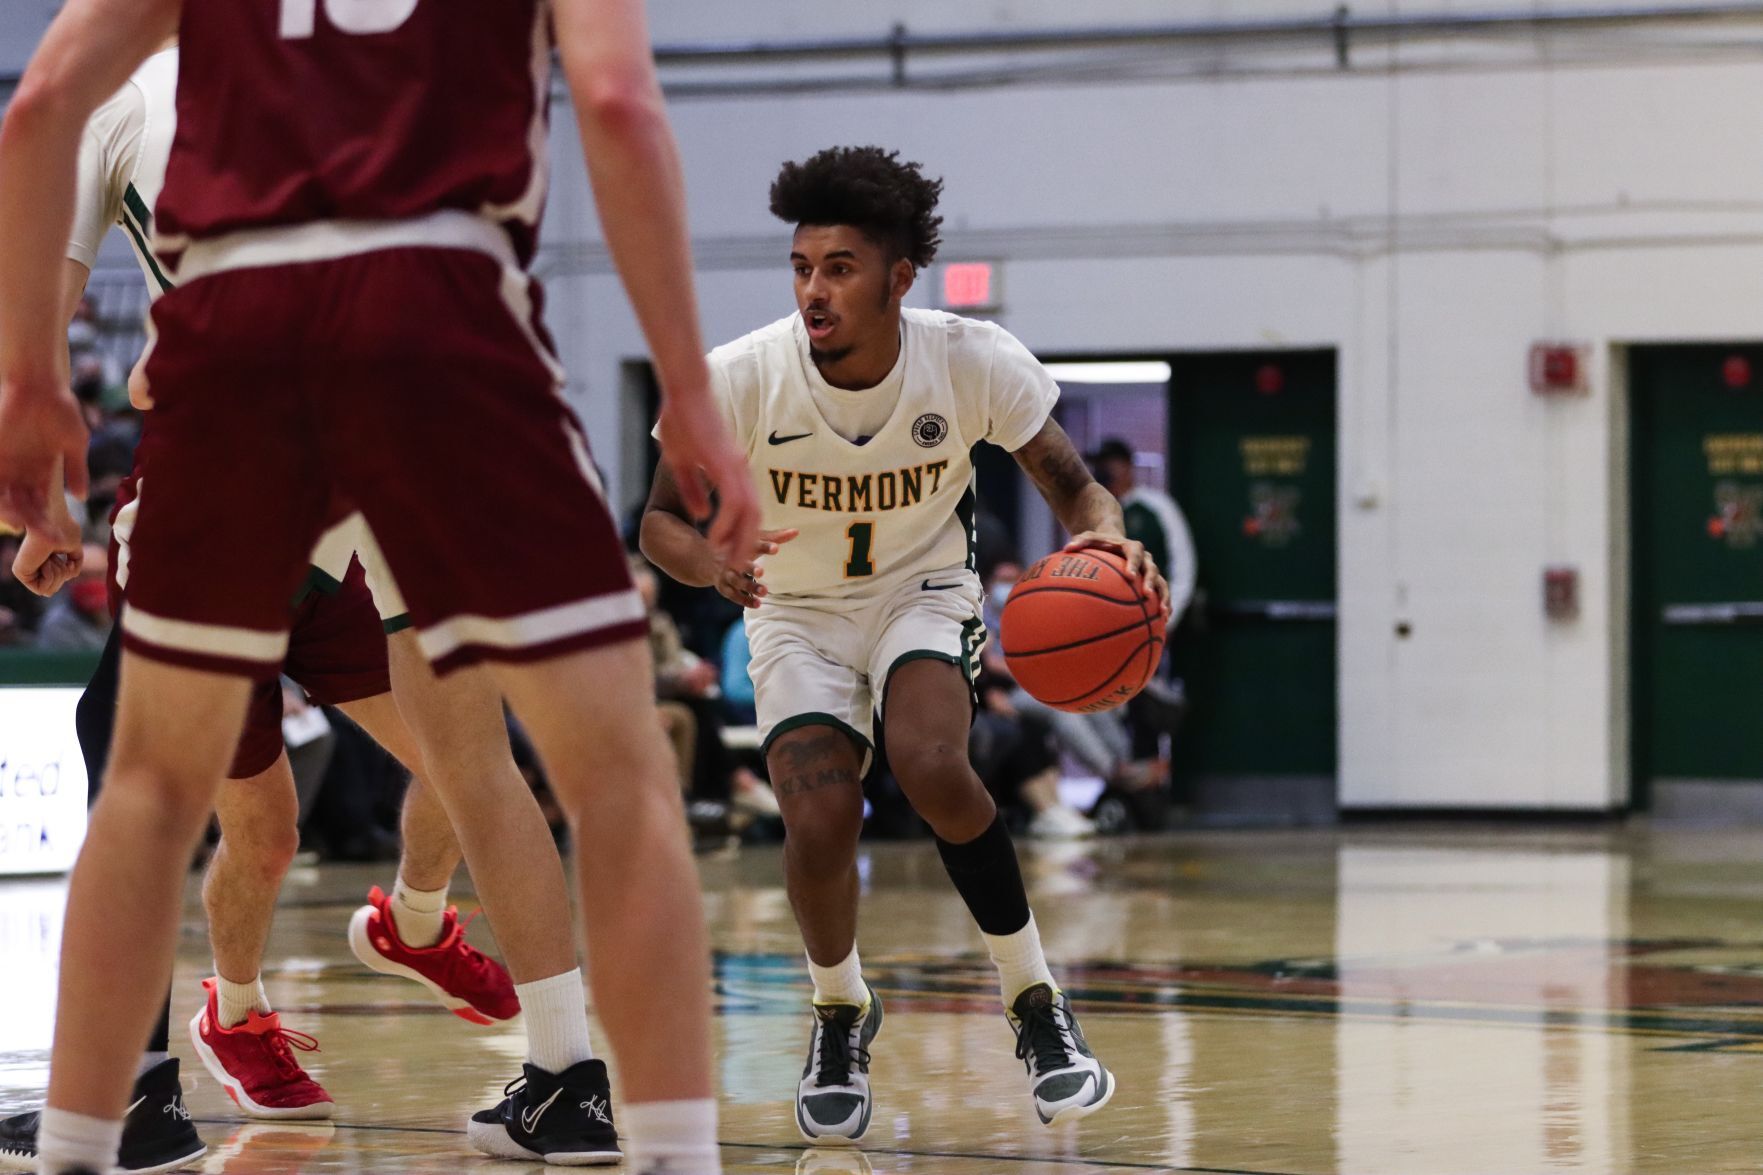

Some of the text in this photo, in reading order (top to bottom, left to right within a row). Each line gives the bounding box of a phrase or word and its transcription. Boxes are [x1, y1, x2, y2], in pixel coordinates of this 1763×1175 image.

[767, 459, 949, 513] VERMONT
[843, 520, 876, 579] 1
[1050, 556, 1100, 581] THE
